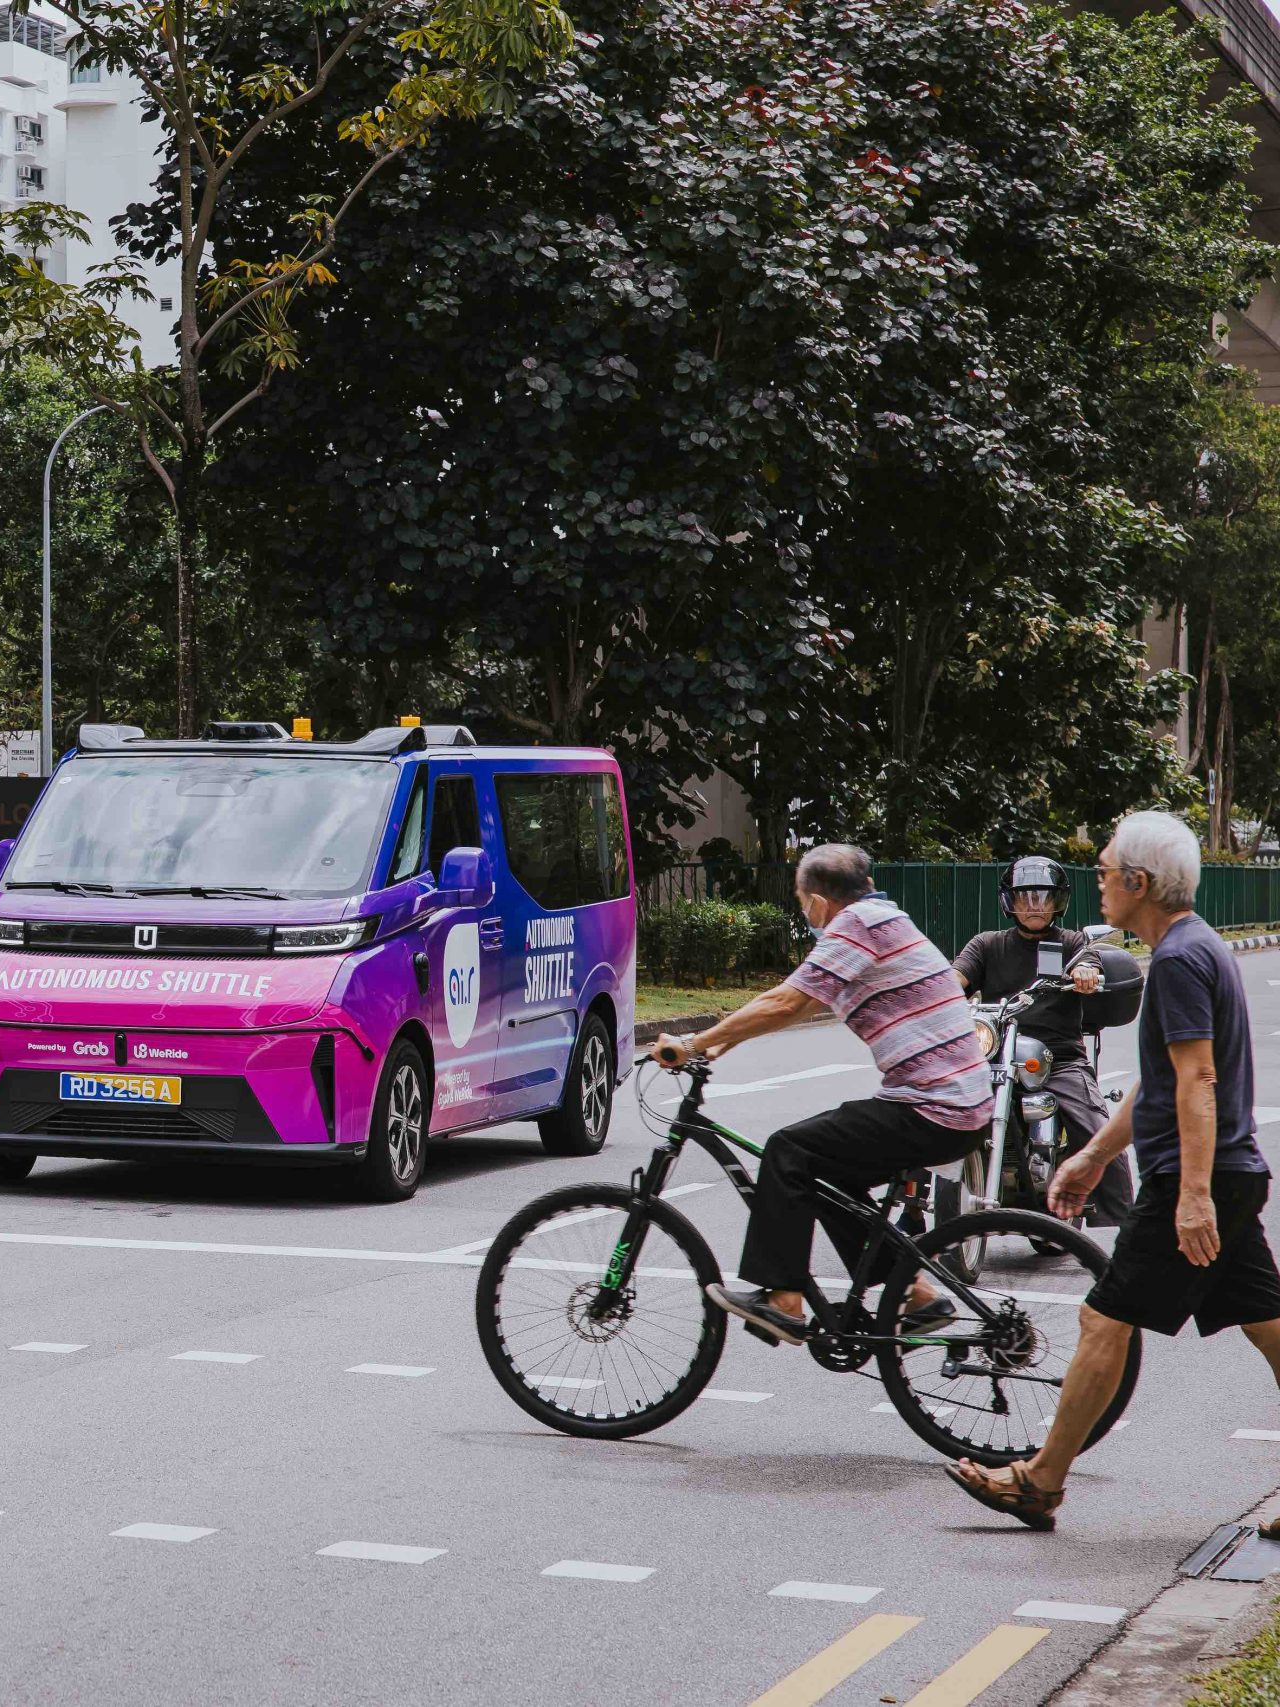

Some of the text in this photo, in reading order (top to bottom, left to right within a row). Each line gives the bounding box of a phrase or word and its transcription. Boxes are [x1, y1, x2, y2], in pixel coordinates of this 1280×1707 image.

[525, 915, 575, 950] AUTONOMOUS
[157, 970, 273, 998] SHUTTLE
[524, 951, 575, 1004] SHUTTLE
[27, 1041, 189, 1059] Powered by Grab WeRide
[69, 1077, 172, 1100] RD 3256 A
